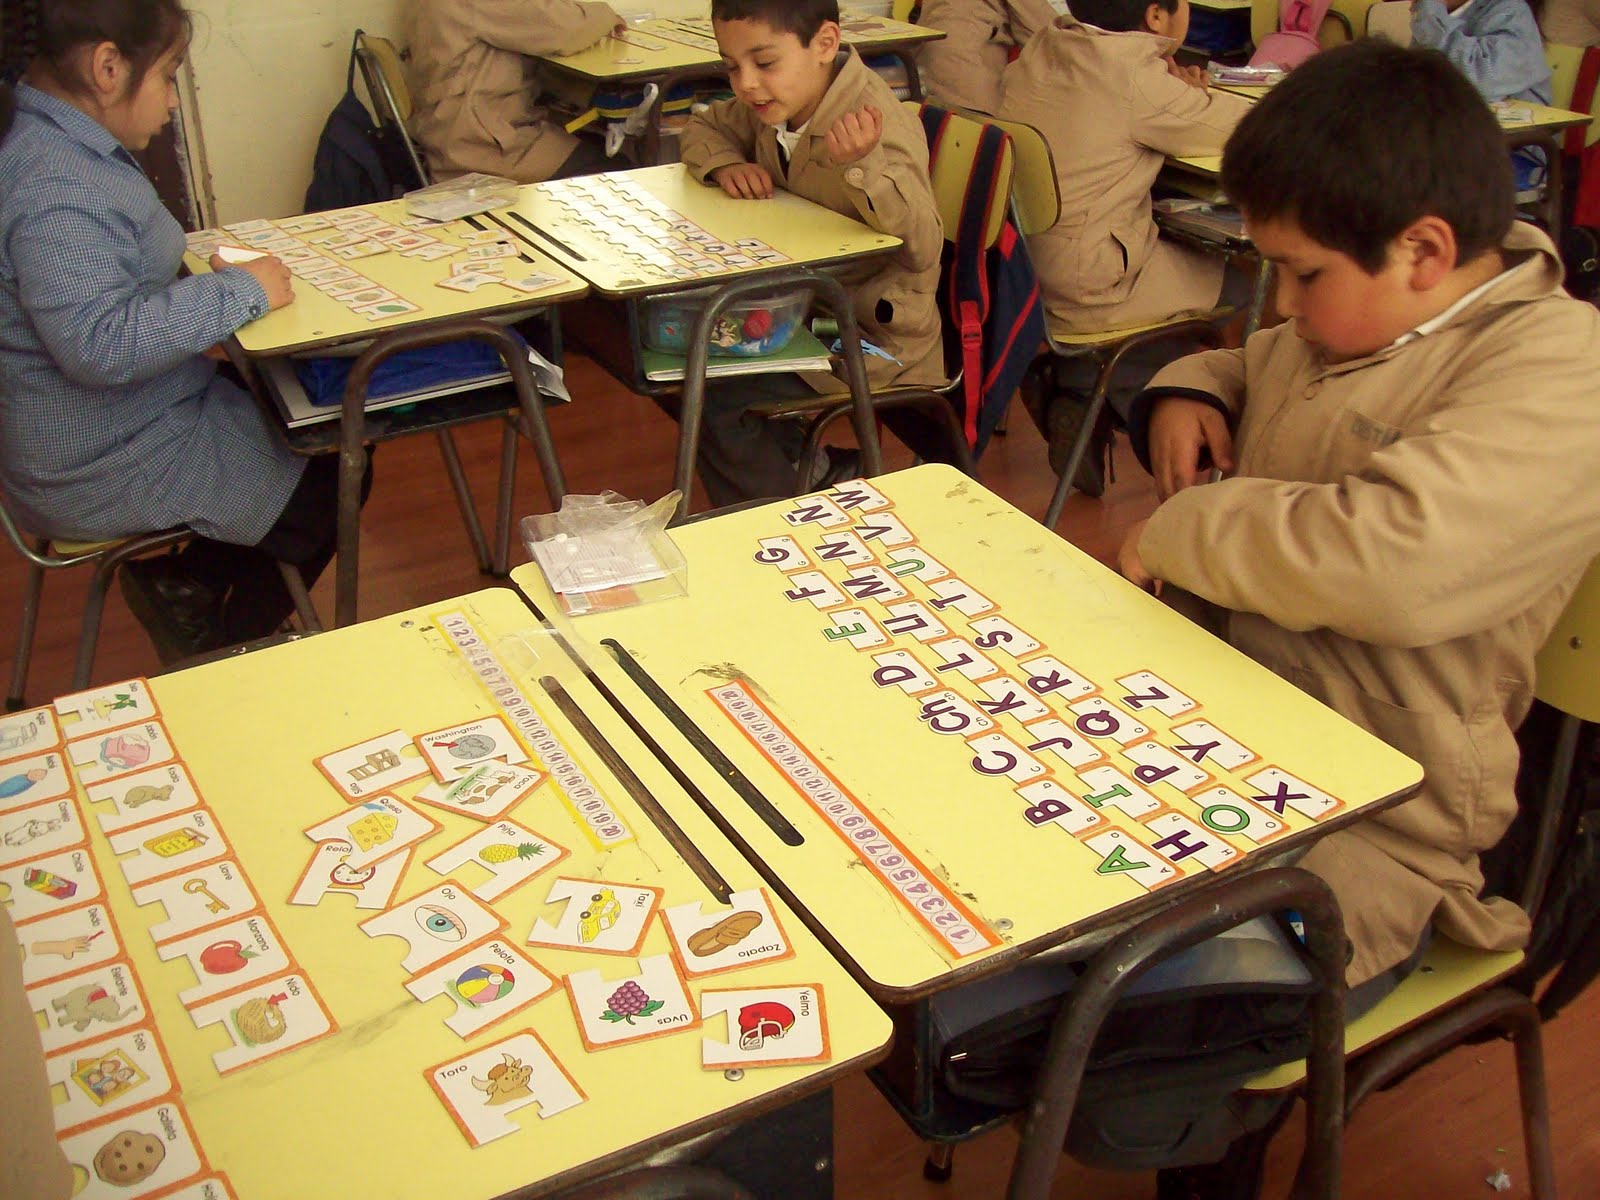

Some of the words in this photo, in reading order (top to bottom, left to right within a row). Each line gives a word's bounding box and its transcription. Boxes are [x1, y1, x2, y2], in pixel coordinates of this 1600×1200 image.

[829, 490, 870, 510] W
[786, 505, 832, 522] Ñ
[854, 526, 892, 540] V
[755, 548, 790, 563] G
[815, 541, 857, 560] N
[887, 559, 926, 576] U
[785, 587, 826, 600] F
[842, 574, 891, 598] M
[929, 594, 967, 609] T
[453, 629, 469, 637] 2
[824, 622, 867, 640] E
[459, 638, 476, 646] 3
[975, 631, 1013, 648] S
[936, 653, 974, 671] L
[873, 666, 917, 686] D
[1028, 670, 1072, 694] R
[503, 698, 520, 707] 9
[722, 690, 738, 700] 20
[1123, 686, 1170, 709] Z
[733, 701, 748, 710] 19
[976, 691, 1027, 715] K
[514, 708, 531, 717] 10
[742, 712, 758, 721] 18
[919, 699, 971, 732] Ch
[522, 719, 539, 728] 11
[752, 722, 769, 732] 17
[1076, 710, 1120, 736] Q
[145, 724, 158, 741] Jabón
[424, 724, 483, 743] Washington
[530, 729, 547, 739] 12
[762, 733, 779, 743] 16
[538, 740, 556, 750] 13
[772, 744, 790, 754] 15
[1028, 737, 1072, 751] J
[547, 751, 564, 762] 14
[1174, 741, 1222, 763] Y
[783, 755, 801, 765] 14
[972, 750, 1017, 774] C
[167, 767, 180, 784] Koala
[556, 763, 573, 773] 15
[794, 767, 812, 777] 13
[1134, 765, 1180, 784] P
[514, 774, 537, 790] Vaca
[565, 774, 583, 785] 16
[806, 779, 823, 789] 12
[574, 788, 592, 797] 17
[817, 791, 835, 801] 11
[1082, 784, 1133, 808] I
[1251, 781, 1311, 814] X
[57, 801, 72, 822] Conejo
[380, 798, 402, 814] Queso
[583, 800, 601, 811] 18
[829, 804, 847, 814] 10
[1025, 800, 1072, 824] B
[193, 813, 205, 827] Libro
[593, 812, 610, 824] 19
[842, 816, 862, 825] 9
[1202, 804, 1250, 832] O
[497, 823, 516, 837] Piña
[602, 827, 621, 837] 20
[855, 829, 876, 839] 8
[865, 843, 889, 854] 7
[1151, 830, 1209, 862] H
[72, 852, 84, 873] Chicle
[880, 856, 902, 866] 6
[1096, 844, 1151, 874] A
[219, 864, 232, 881] Llave
[891, 869, 915, 881] 5
[442, 888, 456, 900] Ojo
[906, 883, 929, 893] 4
[633, 892, 650, 908] Taxi
[922, 898, 944, 909] 3
[88, 907, 101, 927] Dedo
[936, 913, 958, 925] 2
[246, 919, 269, 951] Manzana
[950, 929, 969, 939] 1
[489, 943, 516, 965] Pelota
[738, 943, 782, 958] Zapato
[111, 967, 128, 996] Elefante
[285, 978, 301, 996] Nido
[799, 990, 810, 1017] Yelmo
[657, 1014, 689, 1025] Uvas
[133, 1033, 146, 1051] Foto
[439, 1064, 468, 1080] Toro
[157, 1107, 177, 1140] Galleta
